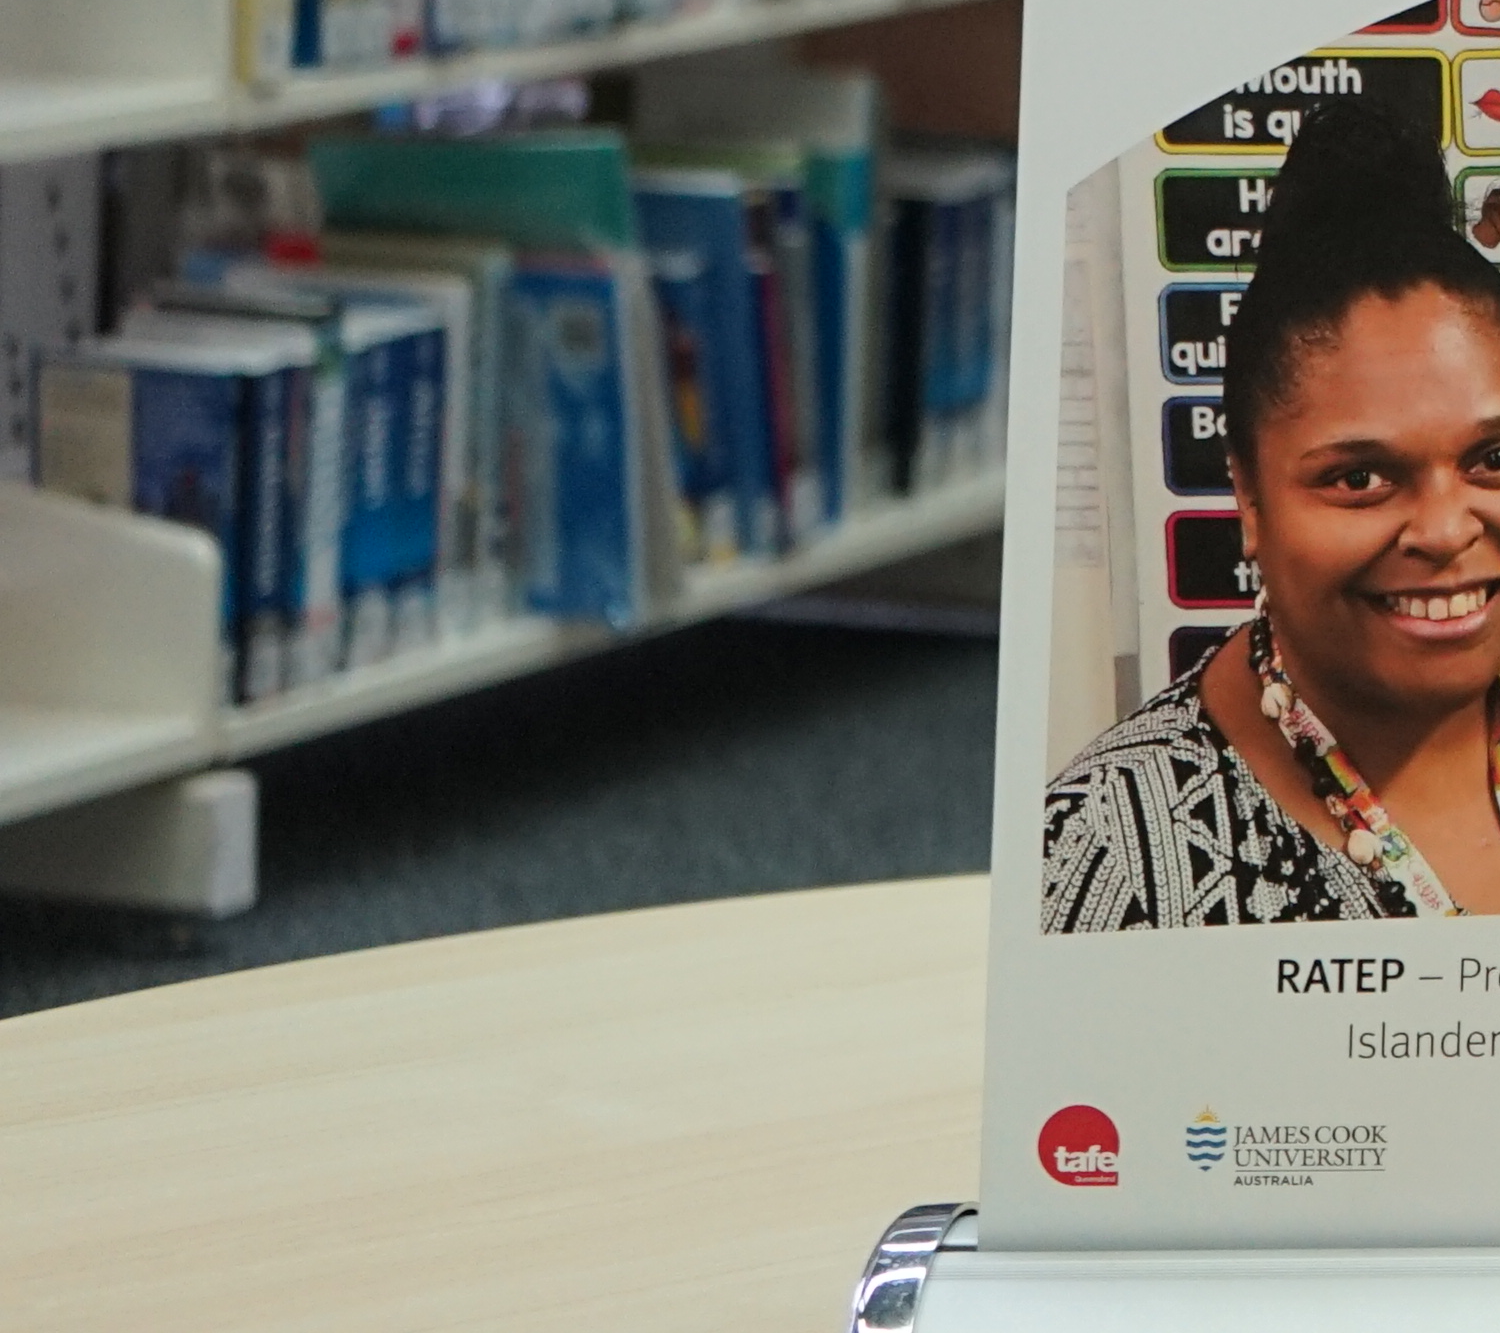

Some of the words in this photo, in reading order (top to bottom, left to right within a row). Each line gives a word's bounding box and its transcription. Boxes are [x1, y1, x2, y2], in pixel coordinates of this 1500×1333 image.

[1222, 103, 1255, 139] is
[1276, 958, 1405, 995] RATEP
[1233, 1125, 1311, 1147] JAMES
[1314, 1124, 1388, 1145] COOK
[1053, 1144, 1119, 1173] tafe
[1233, 1147, 1388, 1168] UNIVERSITY
[1233, 1175, 1315, 1187] AUSTRALIA
